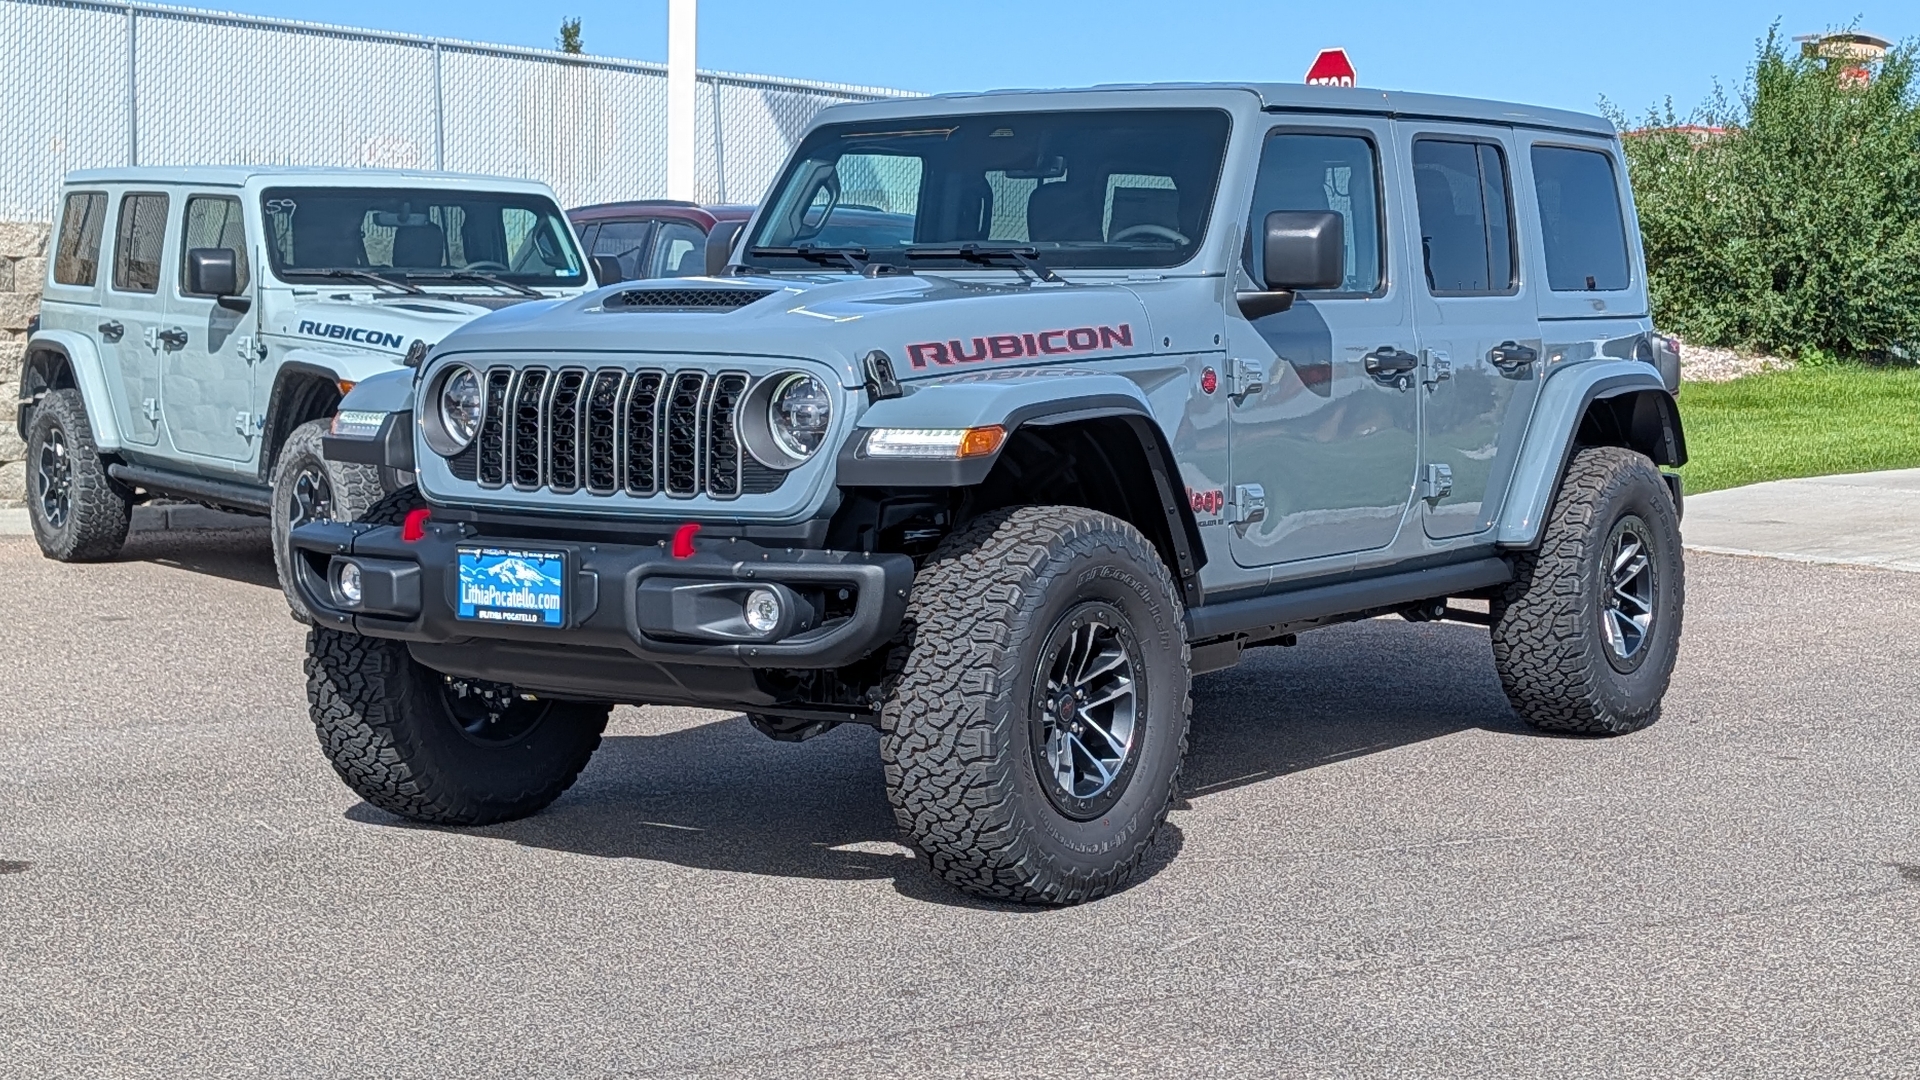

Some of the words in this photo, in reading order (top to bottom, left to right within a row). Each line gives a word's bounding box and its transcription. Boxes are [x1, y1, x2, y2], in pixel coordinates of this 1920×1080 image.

[299, 319, 404, 348] RUBICON
[906, 323, 1133, 369] RUBICON
[462, 583, 560, 609] LithiaPocatello.com
